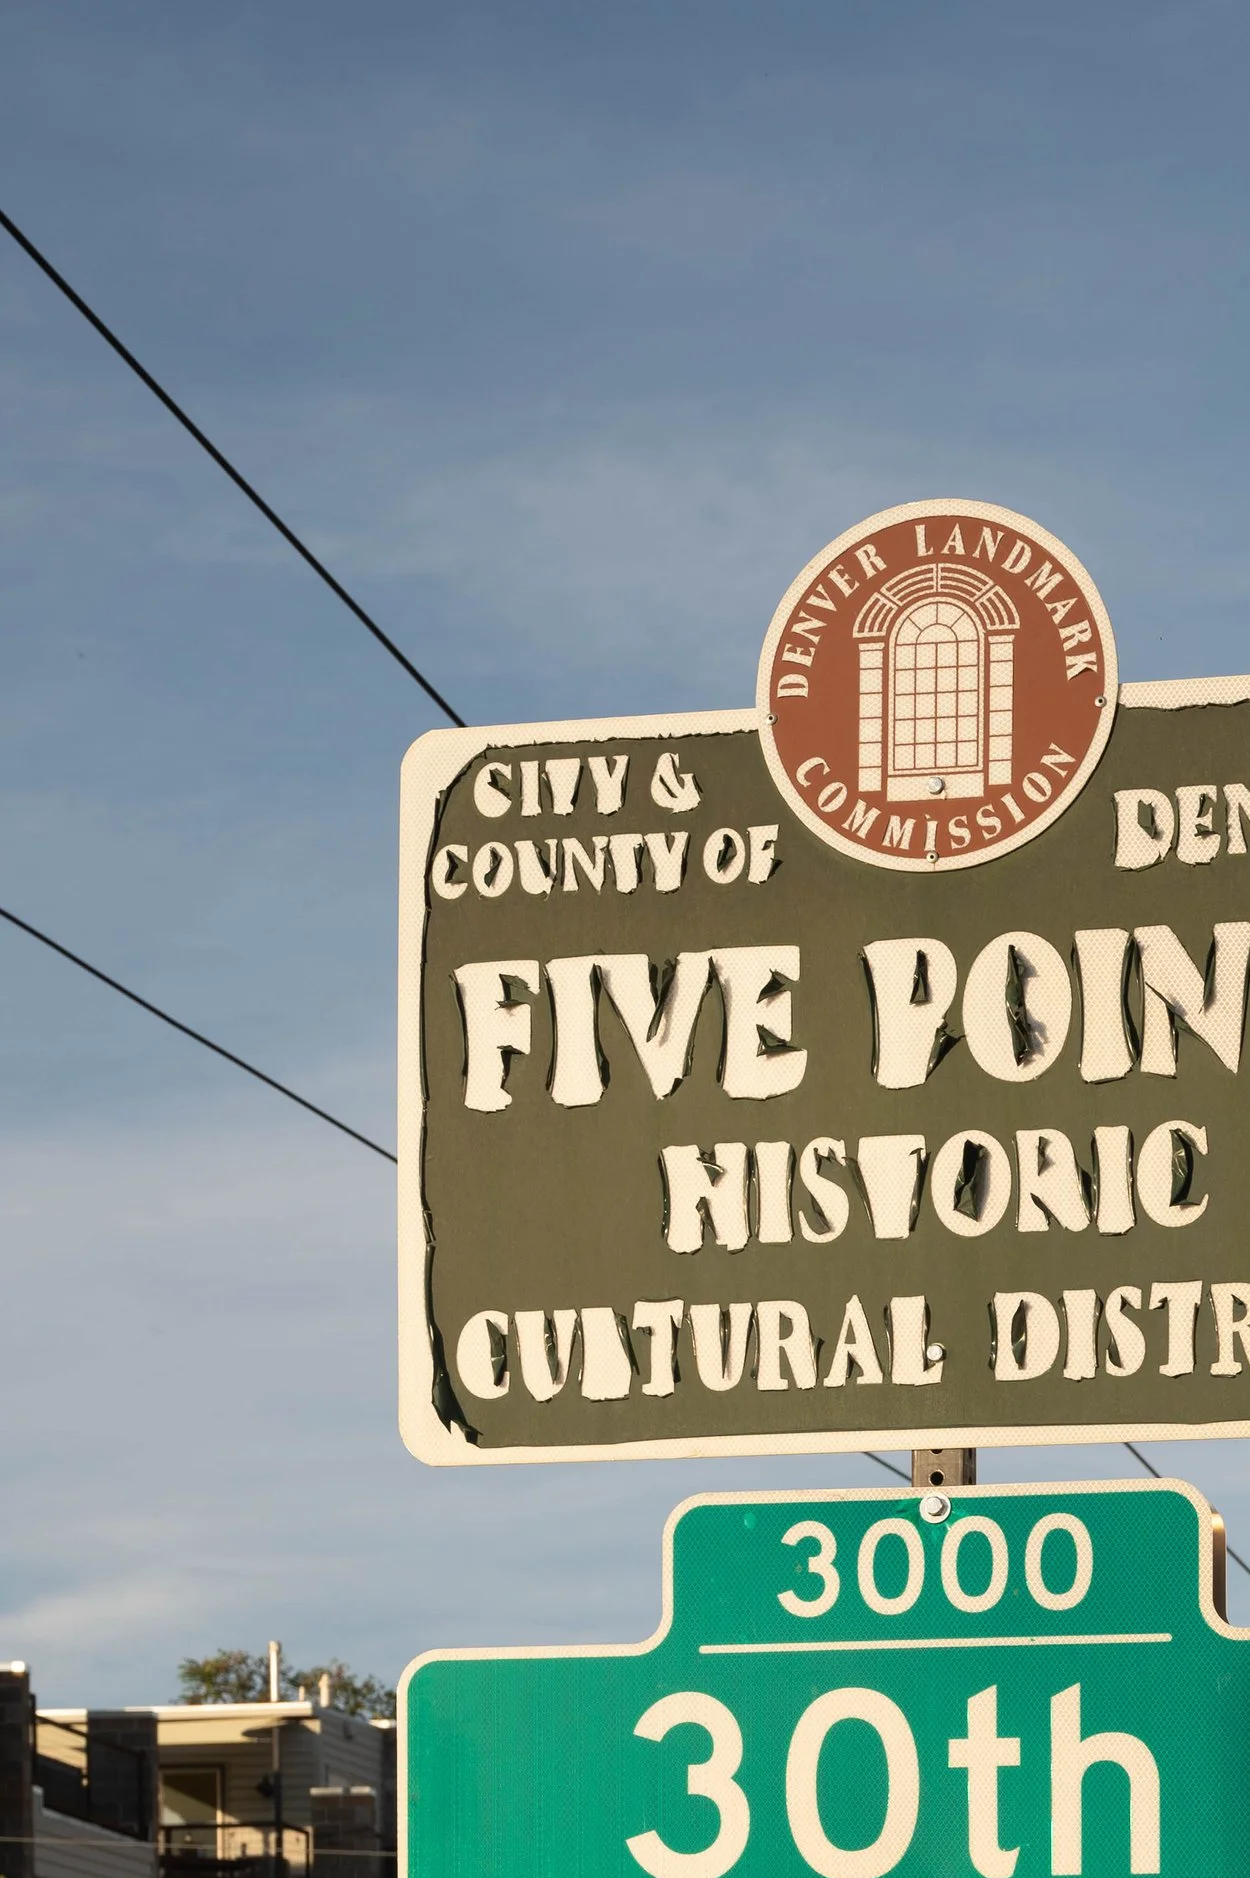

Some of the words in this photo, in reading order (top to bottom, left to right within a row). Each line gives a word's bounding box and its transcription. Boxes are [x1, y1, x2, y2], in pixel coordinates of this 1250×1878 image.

[777, 543, 887, 699] DENVER
[915, 523, 1098, 682] LANDMARK
[473, 754, 631, 818] CITY
[651, 752, 703, 814] &
[796, 742, 1076, 850] COMMISSION
[431, 831, 690, 900] COUNTY
[703, 824, 782, 886] OF
[453, 944, 808, 1114] FIVE
[660, 1120, 1210, 1254] HISTORIC
[456, 1293, 946, 1402] CULTURAL
[776, 1511, 1095, 1619] 3000
